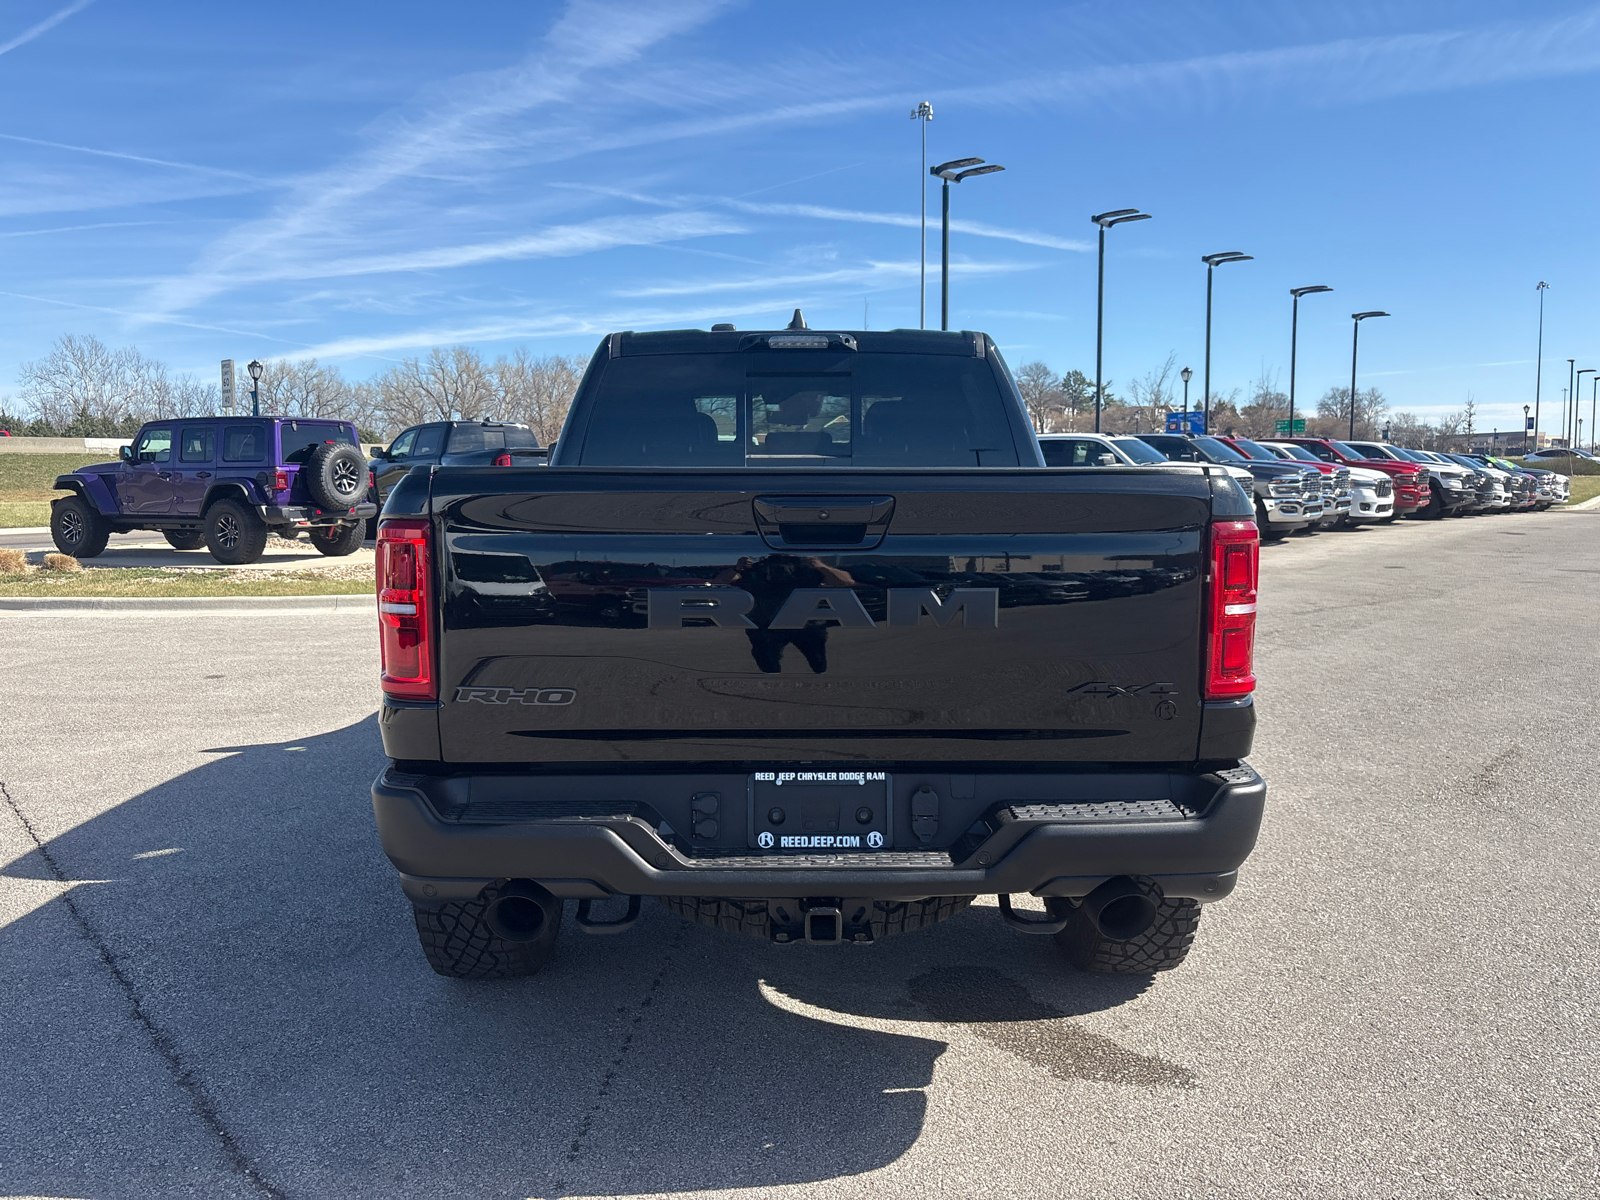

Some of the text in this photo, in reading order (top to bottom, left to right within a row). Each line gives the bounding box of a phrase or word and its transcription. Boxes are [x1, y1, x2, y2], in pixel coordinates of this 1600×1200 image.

[647, 587, 999, 629] RAM
[454, 685, 577, 706] RHO
[755, 772, 885, 781] REED JEEP CHRYSLER DODGE RAM
[780, 836, 860, 848] REEDJEEP.COM
